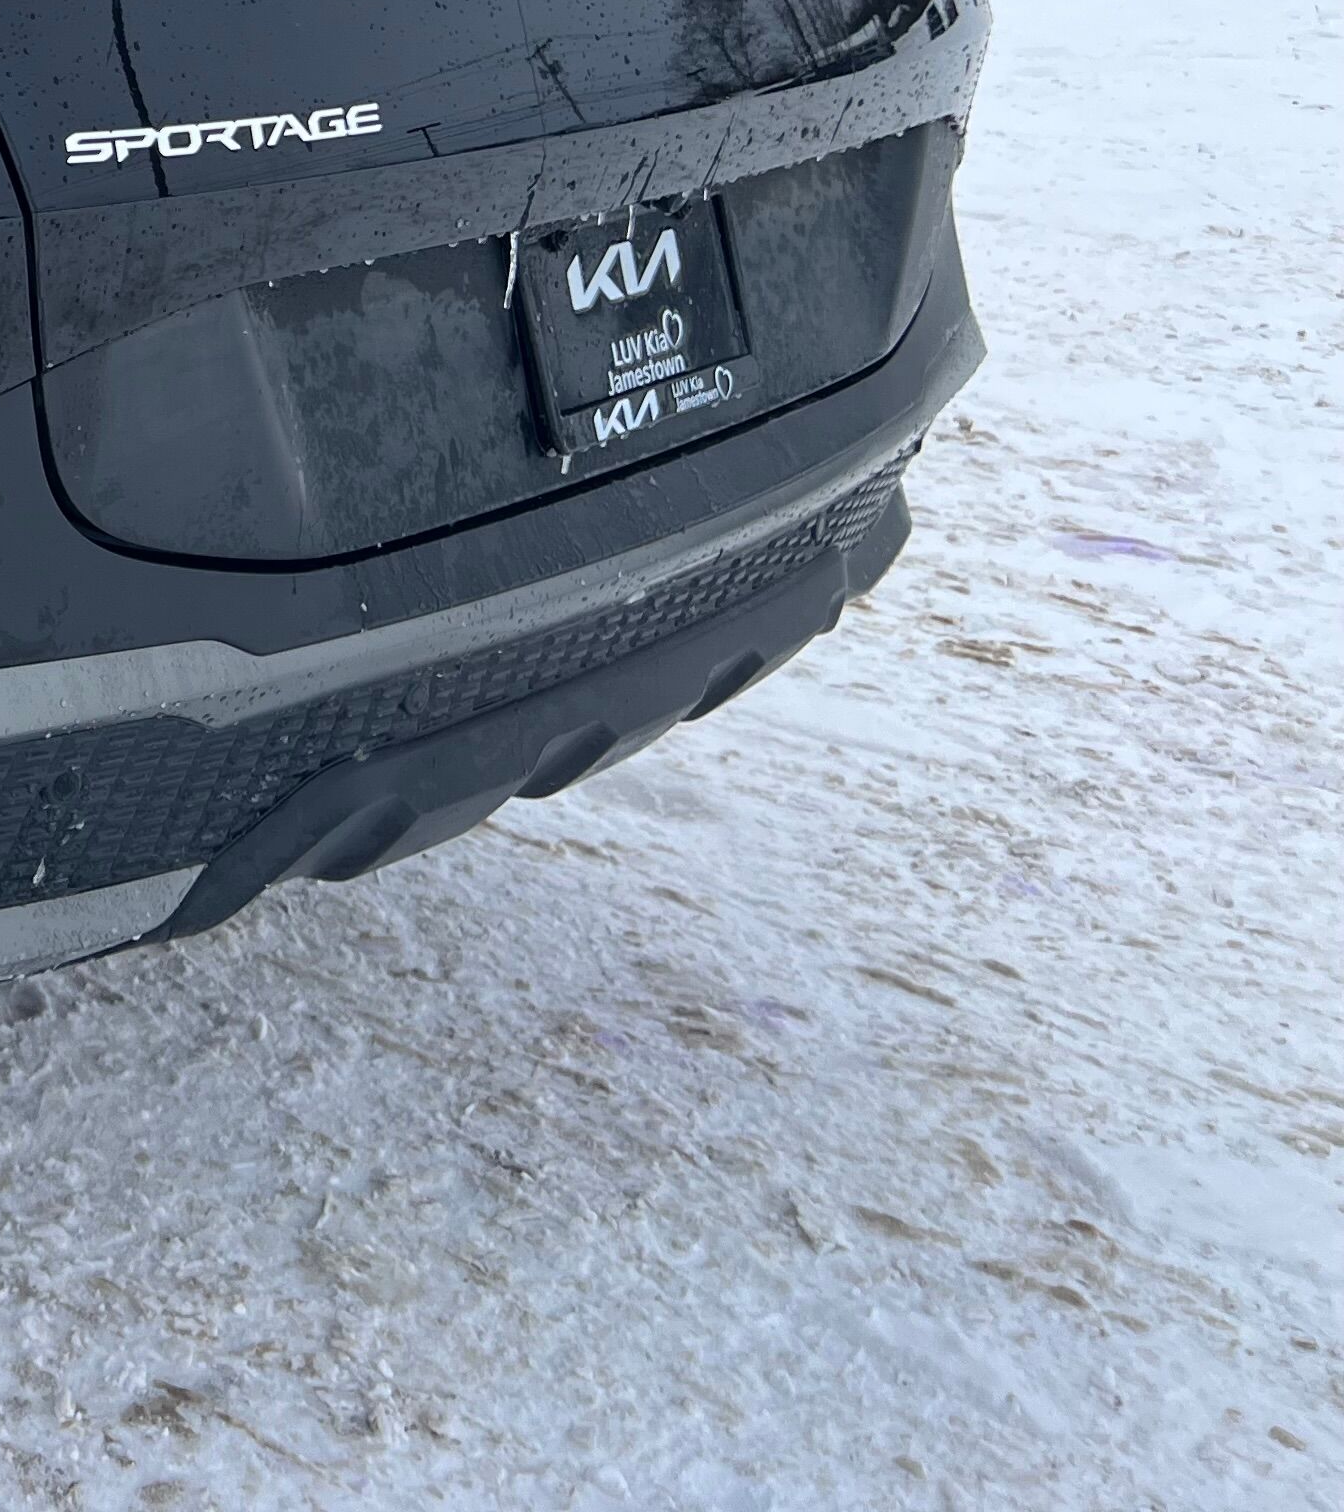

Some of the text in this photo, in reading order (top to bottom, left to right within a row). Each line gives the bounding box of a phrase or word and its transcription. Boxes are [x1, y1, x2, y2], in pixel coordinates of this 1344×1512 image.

[65, 103, 382, 164] SPORTAGE
[566, 228, 681, 314] KIA
[611, 330, 668, 366] LUV Kia
[608, 353, 686, 396] Jamestown
[671, 376, 704, 398] LUV Kia
[593, 389, 659, 441] KIA
[676, 388, 719, 412] Jamestown
